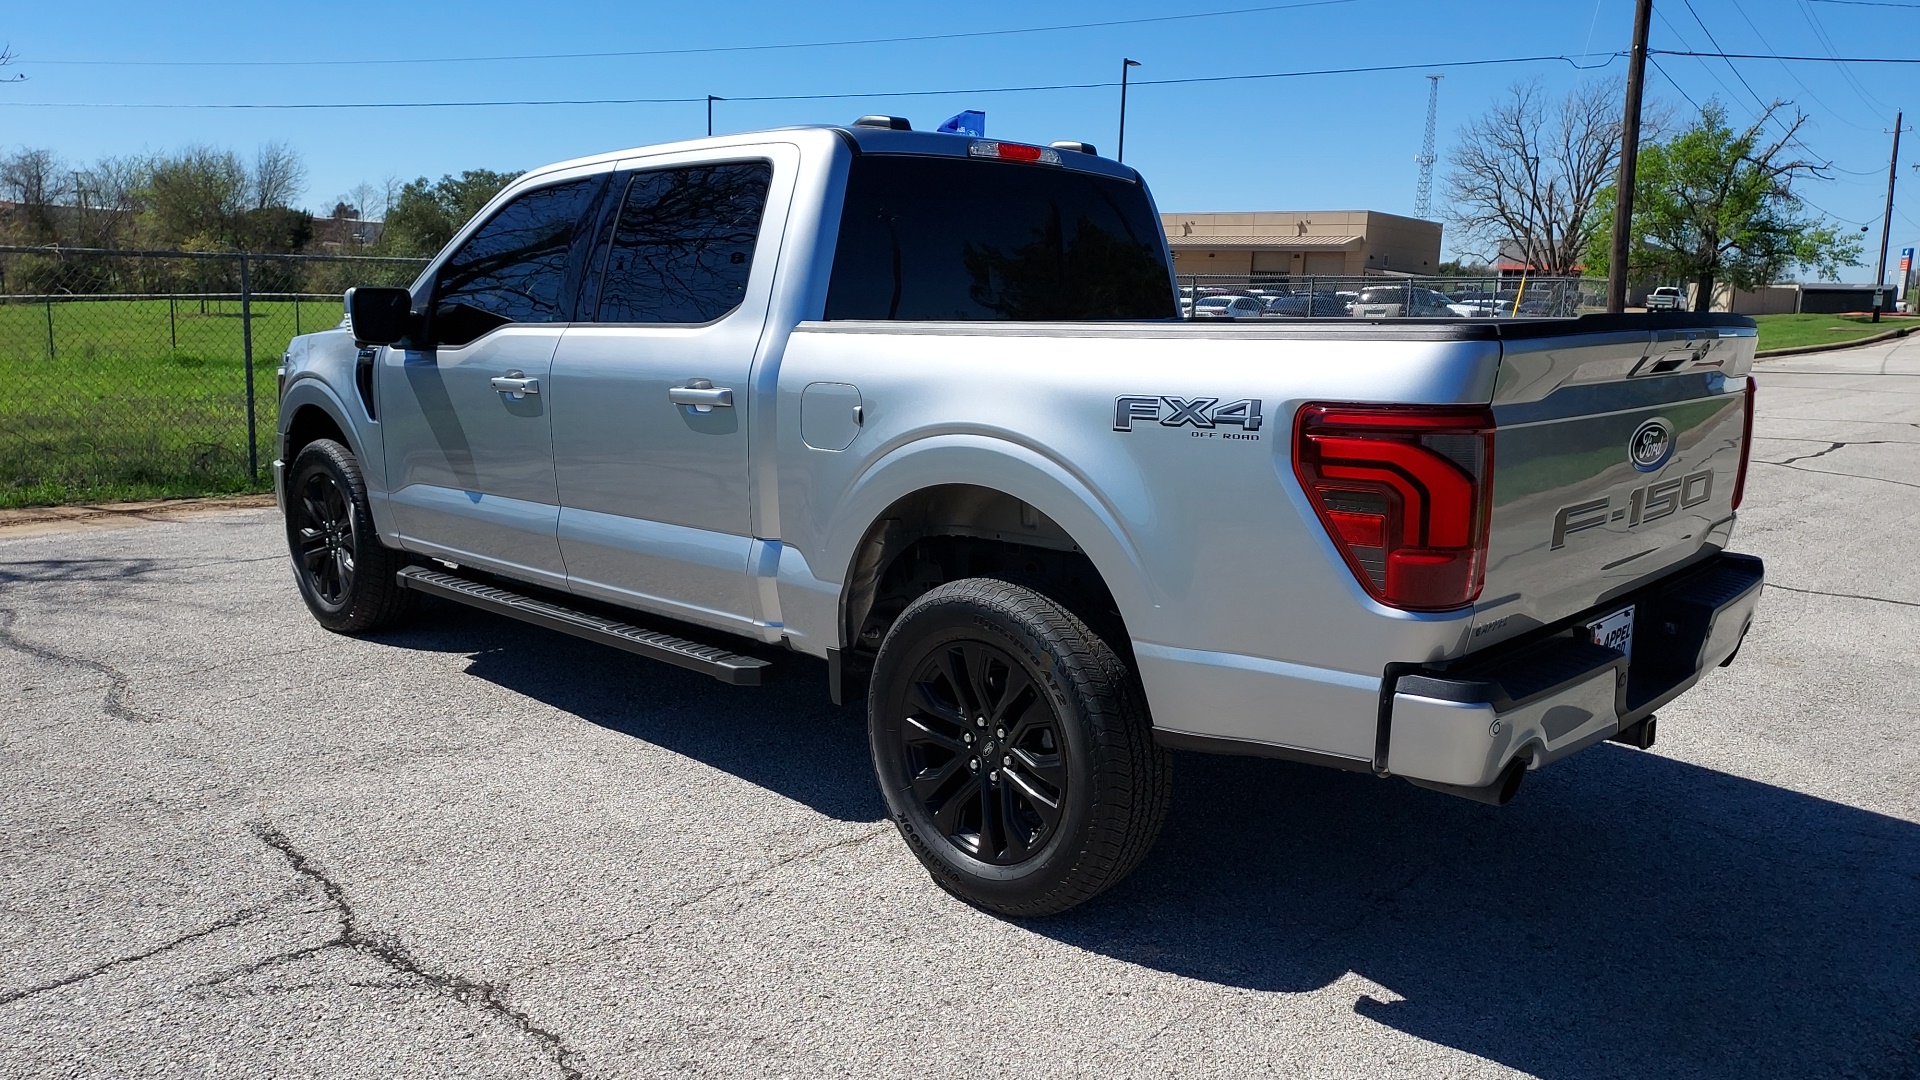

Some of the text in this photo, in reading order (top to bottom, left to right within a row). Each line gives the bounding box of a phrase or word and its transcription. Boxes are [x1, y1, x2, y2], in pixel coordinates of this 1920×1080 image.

[1112, 394, 1263, 432] FX4
[1222, 433, 1260, 441] ROAD
[1640, 430, 1664, 459] Ford
[1550, 468, 1714, 551] F-150
[1604, 622, 1631, 647] APPEL
